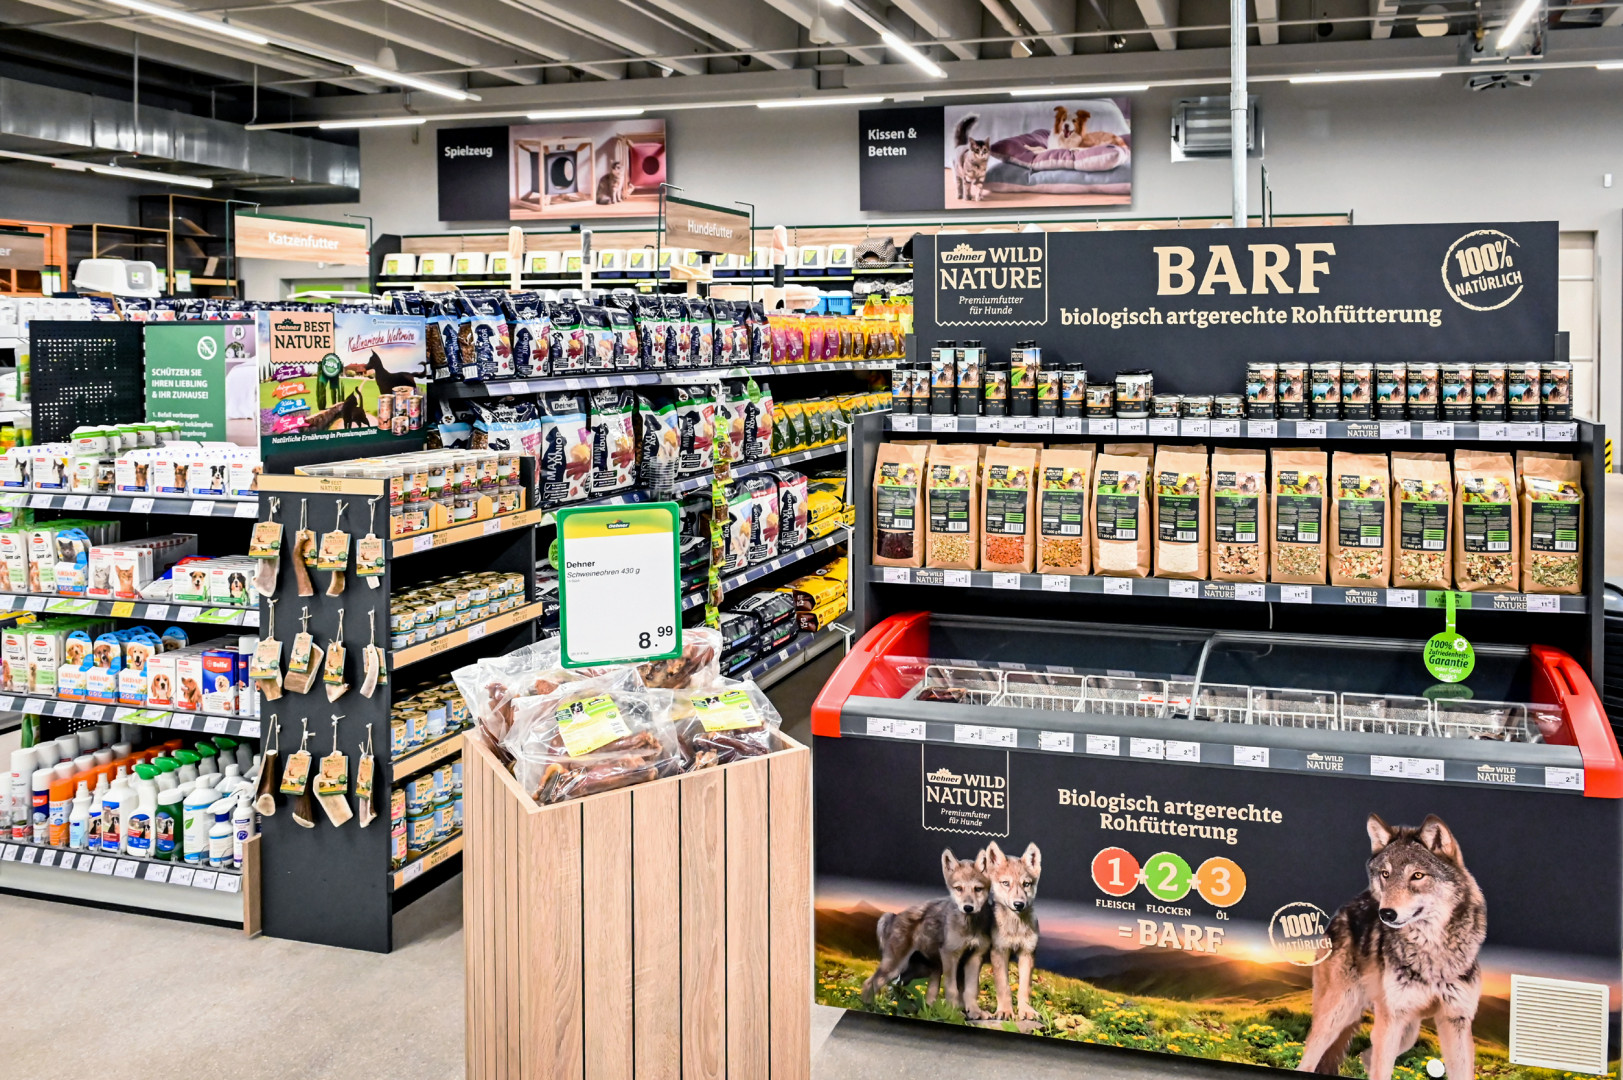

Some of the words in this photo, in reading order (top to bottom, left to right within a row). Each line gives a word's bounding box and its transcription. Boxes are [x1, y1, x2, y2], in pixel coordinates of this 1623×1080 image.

[868, 128, 905, 140] Kissen
[907, 128, 917, 139] &
[444, 145, 493, 158] Spielzeug
[868, 145, 907, 157] Betten
[687, 219, 733, 239] Hundefutter
[268, 232, 339, 250] Katzenfutter
[945, 253, 983, 262] Dehner
[988, 247, 1043, 263] WILD
[1455, 239, 1513, 278] 100%
[1153, 242, 1336, 295] BARF
[940, 267, 1042, 290] NATURE
[1455, 270, 1523, 297] NATÜRLICH
[959, 295, 1023, 305] Premiumfutter
[969, 305, 982, 315] für
[984, 305, 1013, 315] Hunde
[1060, 307, 1163, 329] biologisch
[1167, 306, 1287, 328] artgerechte
[1292, 305, 1442, 327] Rohfütterung
[305, 321, 331, 332] BEST
[275, 335, 331, 349] NATURE
[348, 332, 385, 351] Kulinarische
[387, 328, 415, 343] Weltreise
[151, 367, 189, 376] SCHÜTZEN
[191, 368, 202, 376] SIE
[175, 380, 208, 388] LIEBLING
[151, 391, 157, 399] &
[159, 391, 170, 399] IHR
[172, 391, 209, 399] ZUHAUSE!
[272, 435, 301, 444] Natürliche
[302, 432, 329, 442] Ernährung
[336, 428, 378, 438] Premiumqualität
[1347, 429, 1378, 437] NATURE
[555, 432, 563, 465] JUNIOR
[644, 435, 652, 460] MAXI
[547, 452, 556, 480] MAXI
[433, 537, 448, 546] ATURE
[566, 560, 596, 569] Dehner
[566, 569, 620, 579] Schweineohren
[635, 568, 641, 576] g
[1204, 589, 1234, 598] NATURE
[1345, 595, 1377, 604] NATURE
[1493, 601, 1527, 610] NATURE
[1430, 640, 1453, 650] 100%
[1428, 649, 1470, 659] Zufriedenheits-
[1428, 655, 1469, 668] Garantie
[1448, 666, 1462, 674] Geld
[430, 749, 448, 761] NATURE
[1324, 755, 1343, 763] WILD
[1306, 761, 1343, 771] NATURE
[1495, 766, 1516, 775] WILD
[929, 774, 960, 785] Dehner
[963, 773, 1006, 789] WILD
[1477, 773, 1516, 783] NATURE
[926, 785, 1005, 809] NATURE
[1058, 788, 1160, 814] Biologisch
[1164, 797, 1283, 824] artgerechte
[940, 807, 991, 821] Premiumfutter
[948, 816, 959, 825] für
[960, 817, 983, 827] Hunde
[1100, 812, 1238, 845] Rohfütterung
[430, 852, 448, 865] NATURE
[1108, 857, 1125, 886] 1
[1157, 861, 1178, 892] 2
[1210, 866, 1231, 897] 3
[1096, 898, 1136, 911] FLEISCH
[1146, 904, 1192, 917] FLOCKEN
[1216, 909, 1229, 921] ÖL
[1279, 912, 1325, 938] 100%
[1136, 919, 1225, 954] BARF
[1279, 938, 1333, 952] NATÜRLICH
